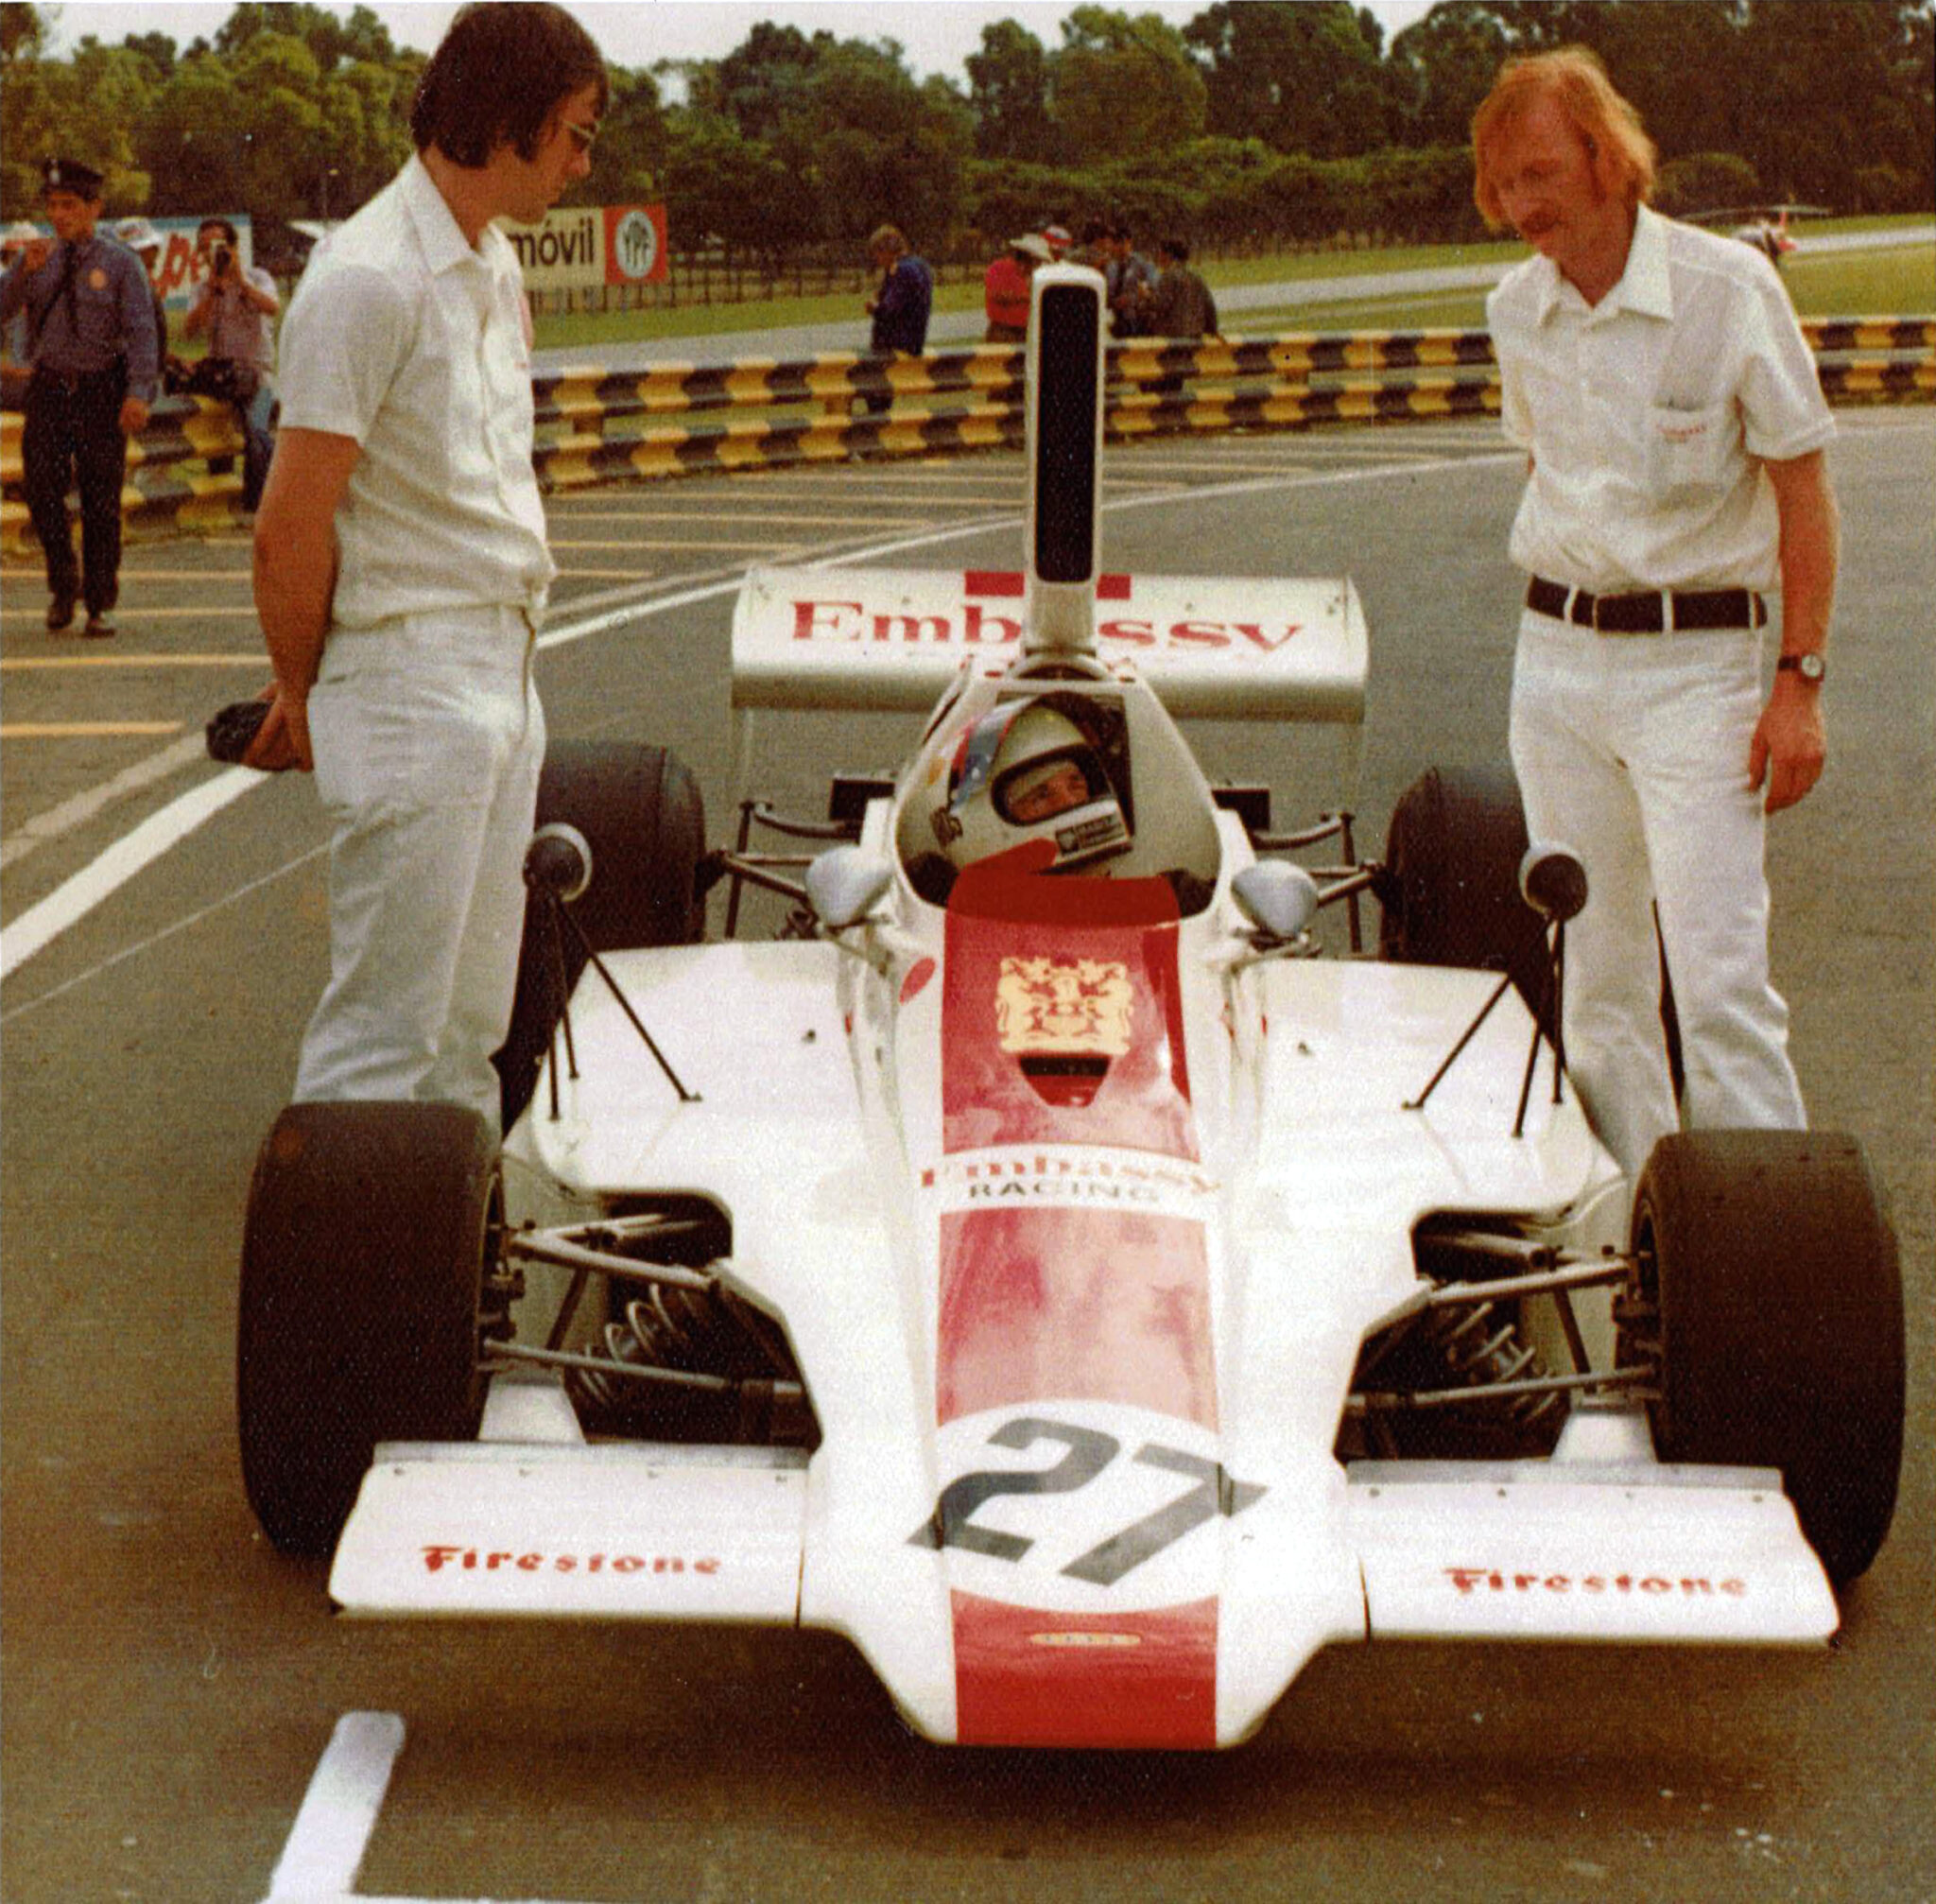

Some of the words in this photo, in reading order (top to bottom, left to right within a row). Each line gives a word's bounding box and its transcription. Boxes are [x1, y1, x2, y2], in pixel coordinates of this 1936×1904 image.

[790, 599, 1303, 654] Embssy
[906, 1416, 1270, 1587] 27
[423, 1545, 720, 1575] Firestone
[1443, 1567, 1745, 1595] Firestone
